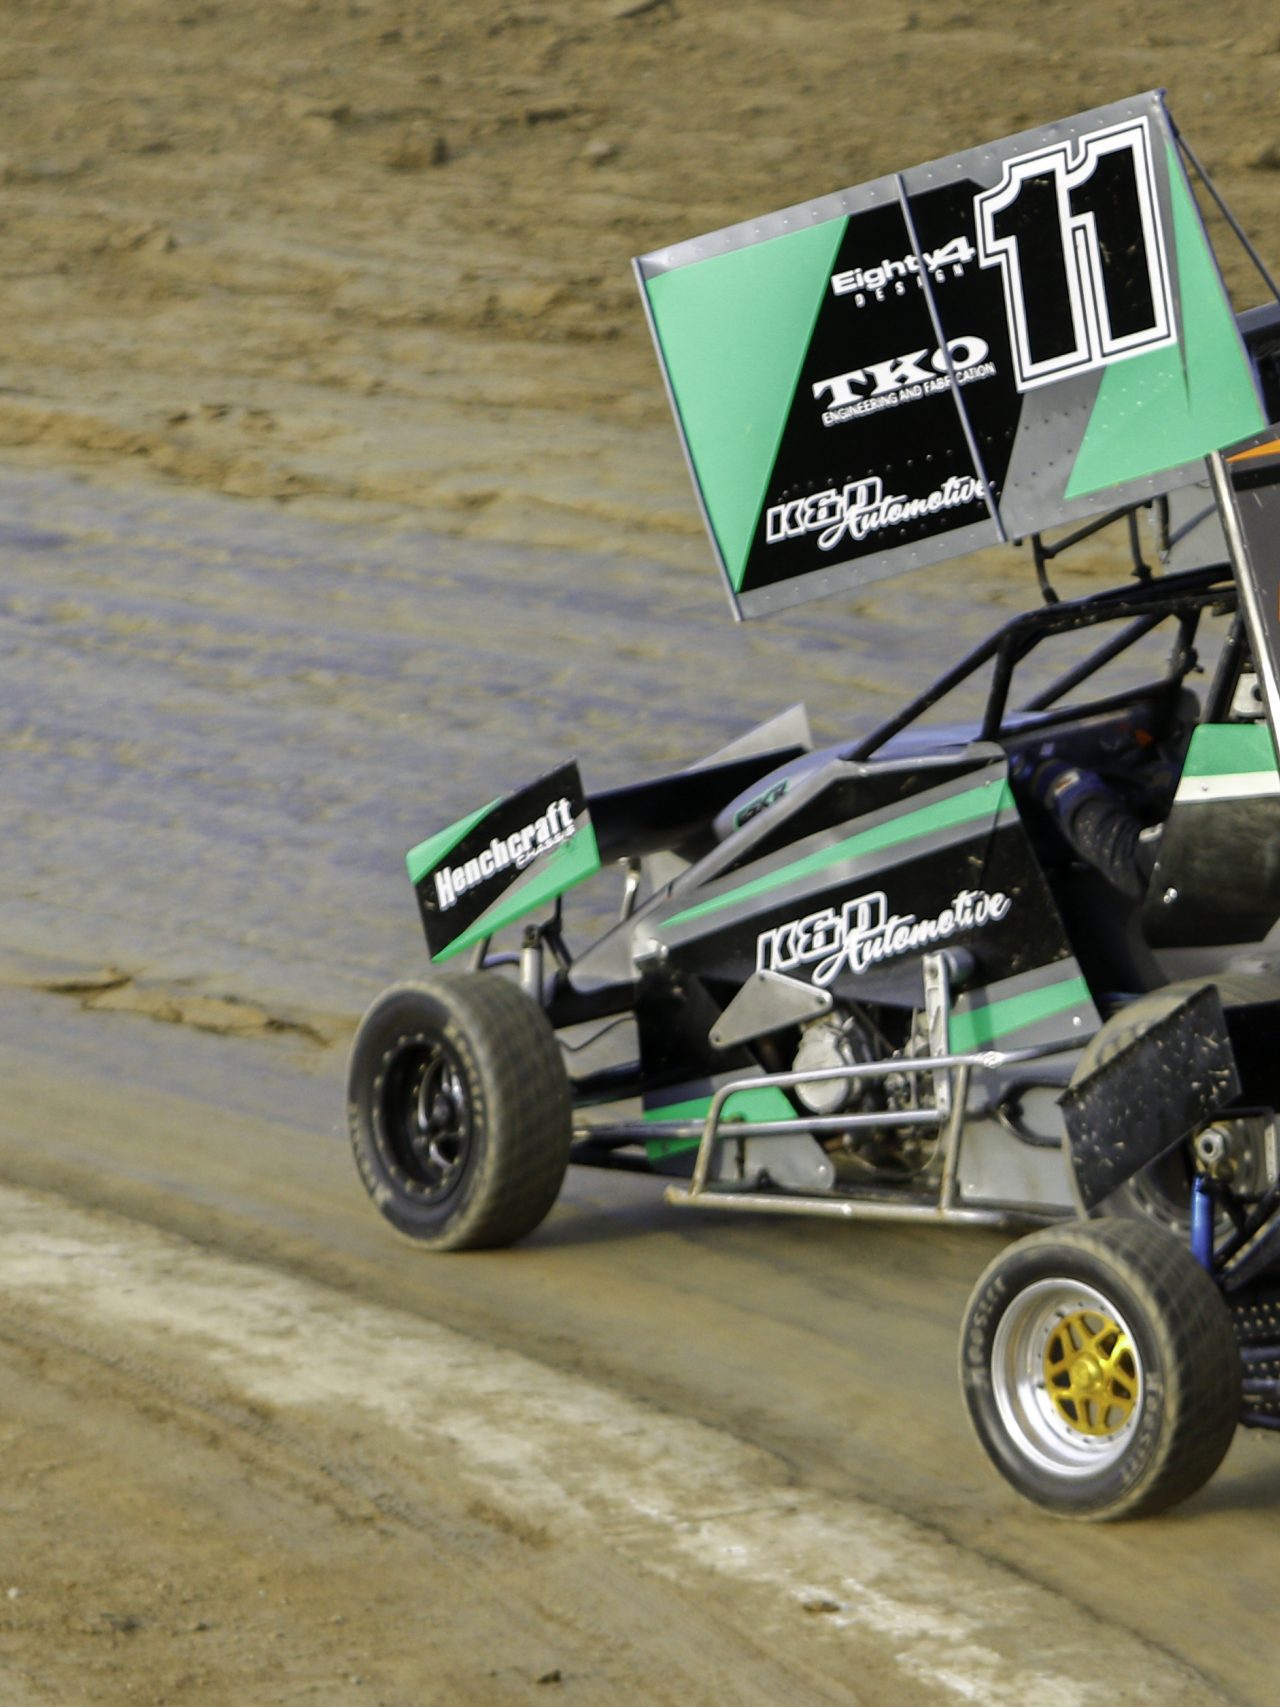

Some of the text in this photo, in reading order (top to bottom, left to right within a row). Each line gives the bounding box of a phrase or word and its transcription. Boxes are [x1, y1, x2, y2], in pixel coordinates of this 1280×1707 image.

[831, 236, 975, 296] Eighty4
[974, 115, 1178, 393] 11
[812, 335, 989, 410] TKO
[821, 362, 997, 427] ENGINEERING AND FABRCATION
[434, 797, 574, 912] Henchcraft
[811, 889, 1012, 987] Automotive
